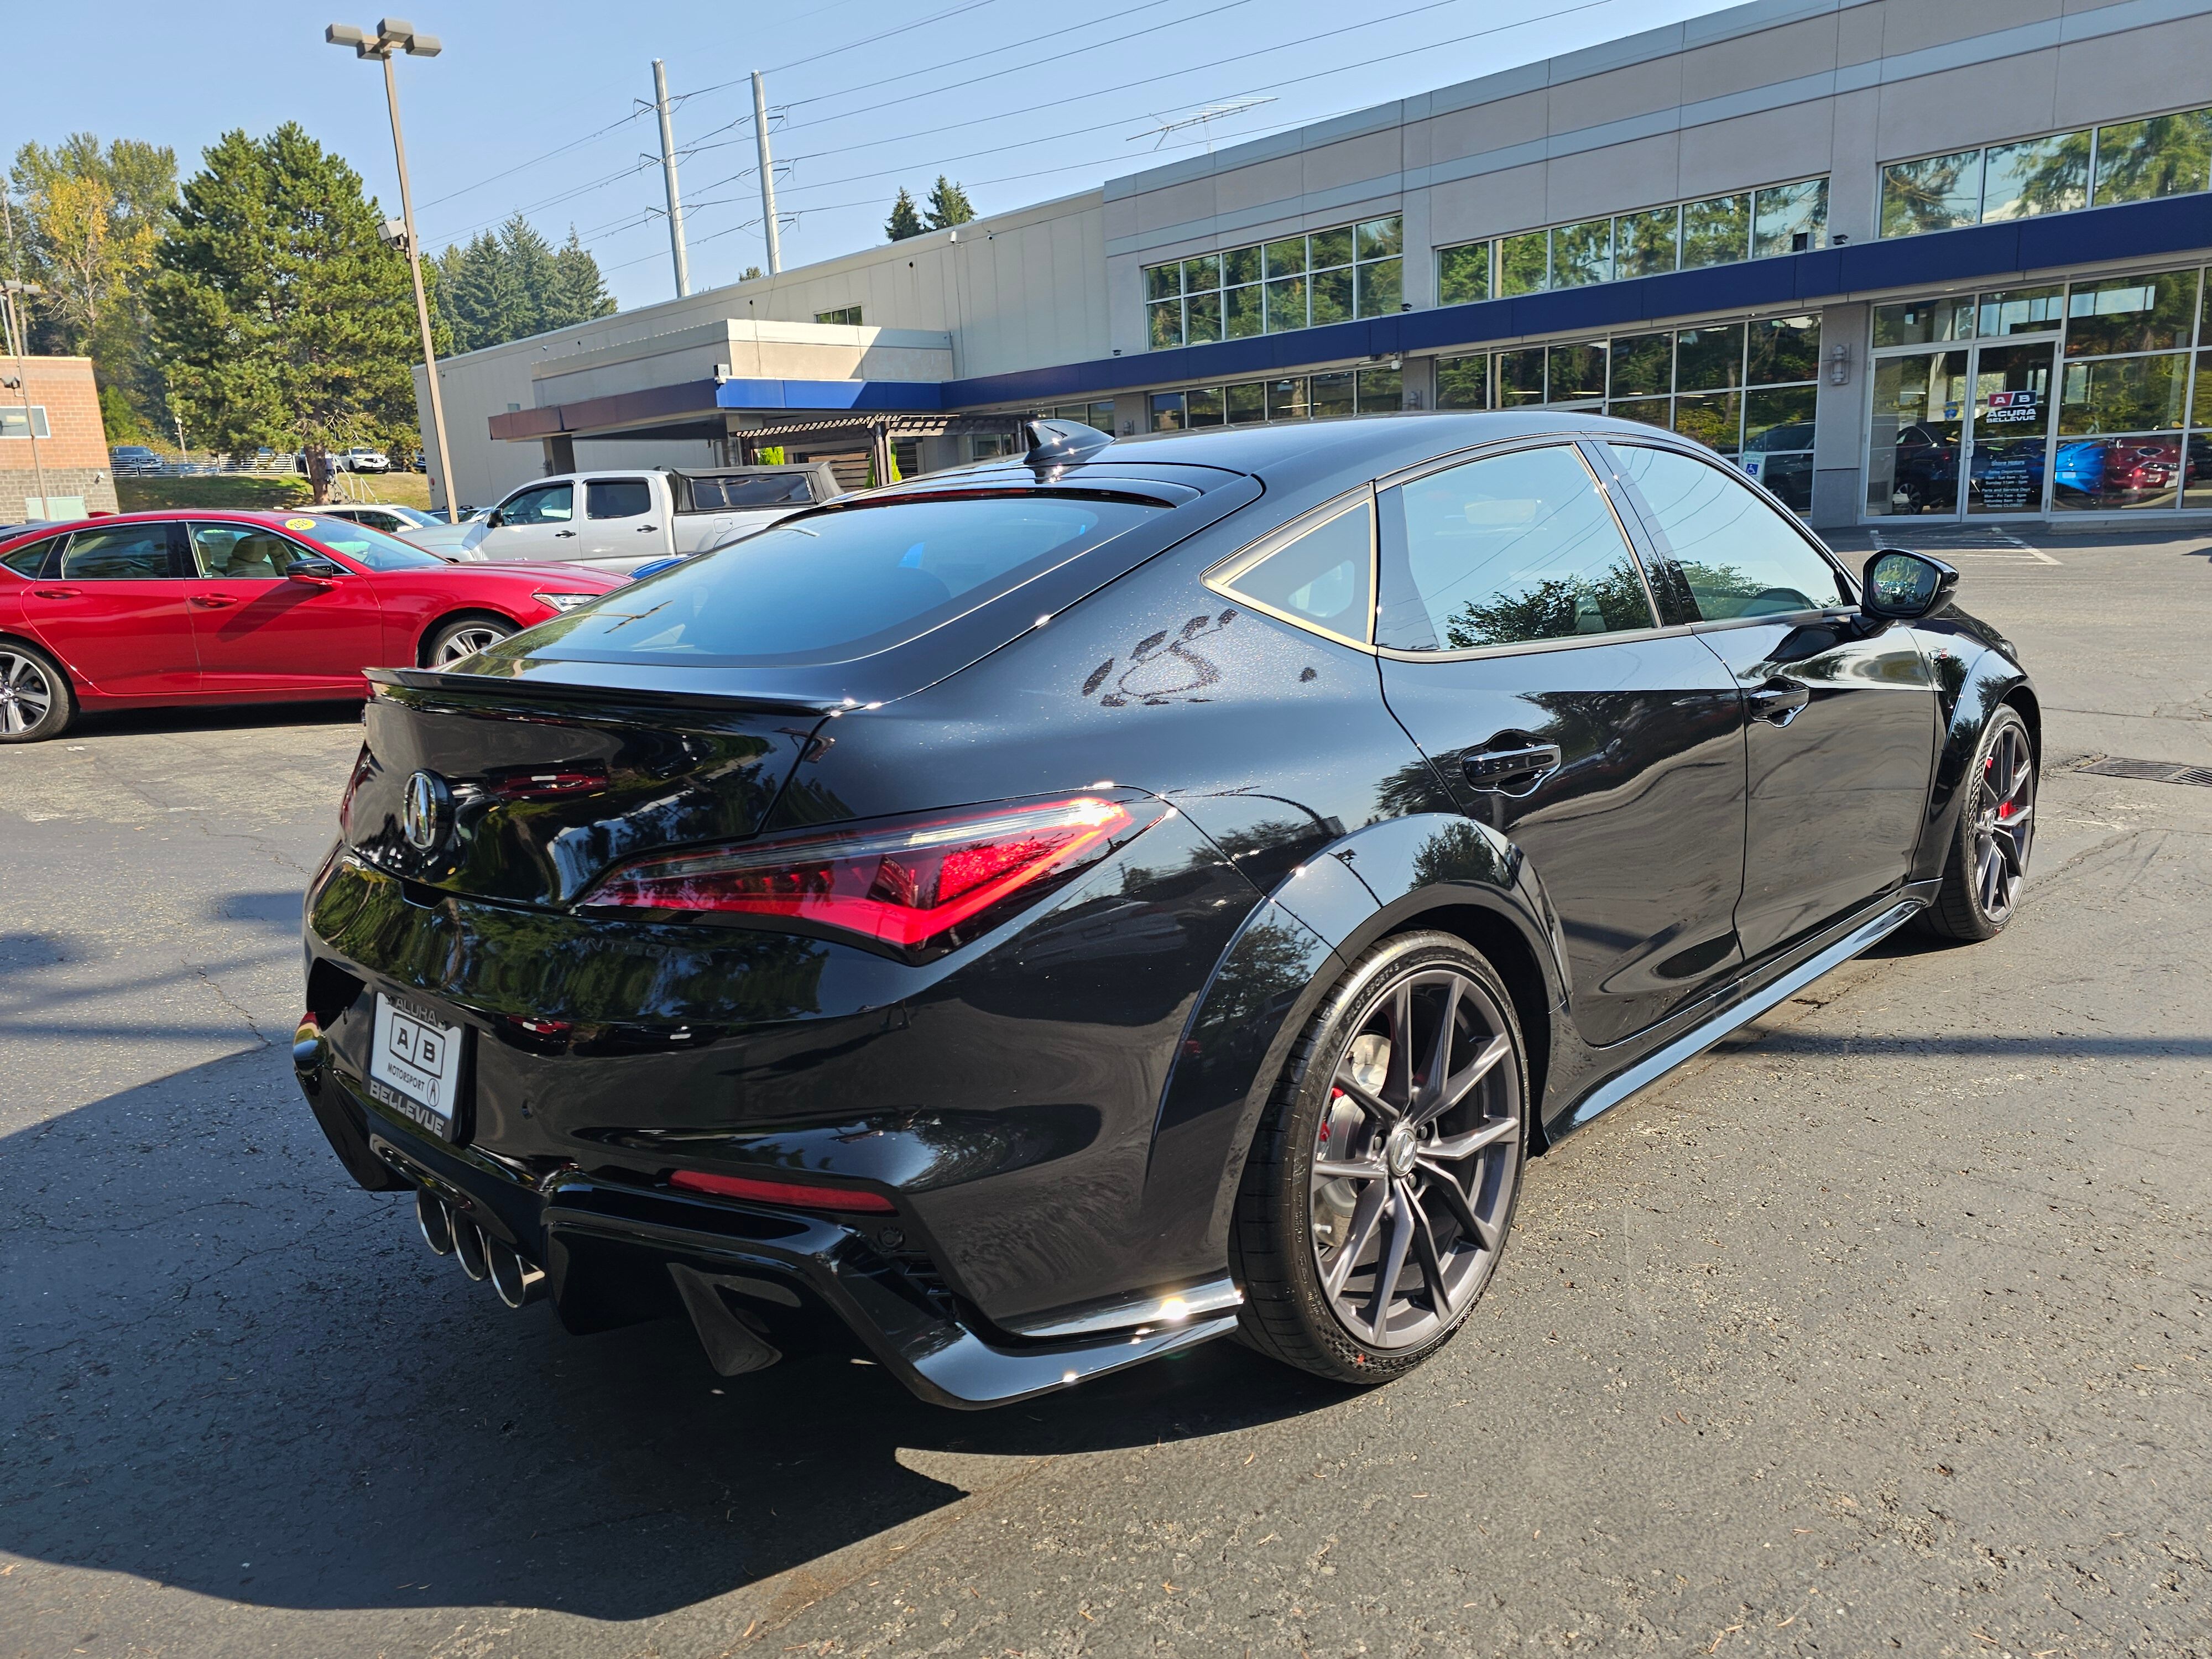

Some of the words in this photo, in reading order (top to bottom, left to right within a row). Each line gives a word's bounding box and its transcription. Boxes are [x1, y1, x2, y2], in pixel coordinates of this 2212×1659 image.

[1986, 409, 2036, 418] ACURA
[397, 1027, 408, 1050] A
[423, 1040, 435, 1063] B
[388, 1062, 425, 1092] MOTORSPORT
[369, 1079, 444, 1138] BELLEVUE
